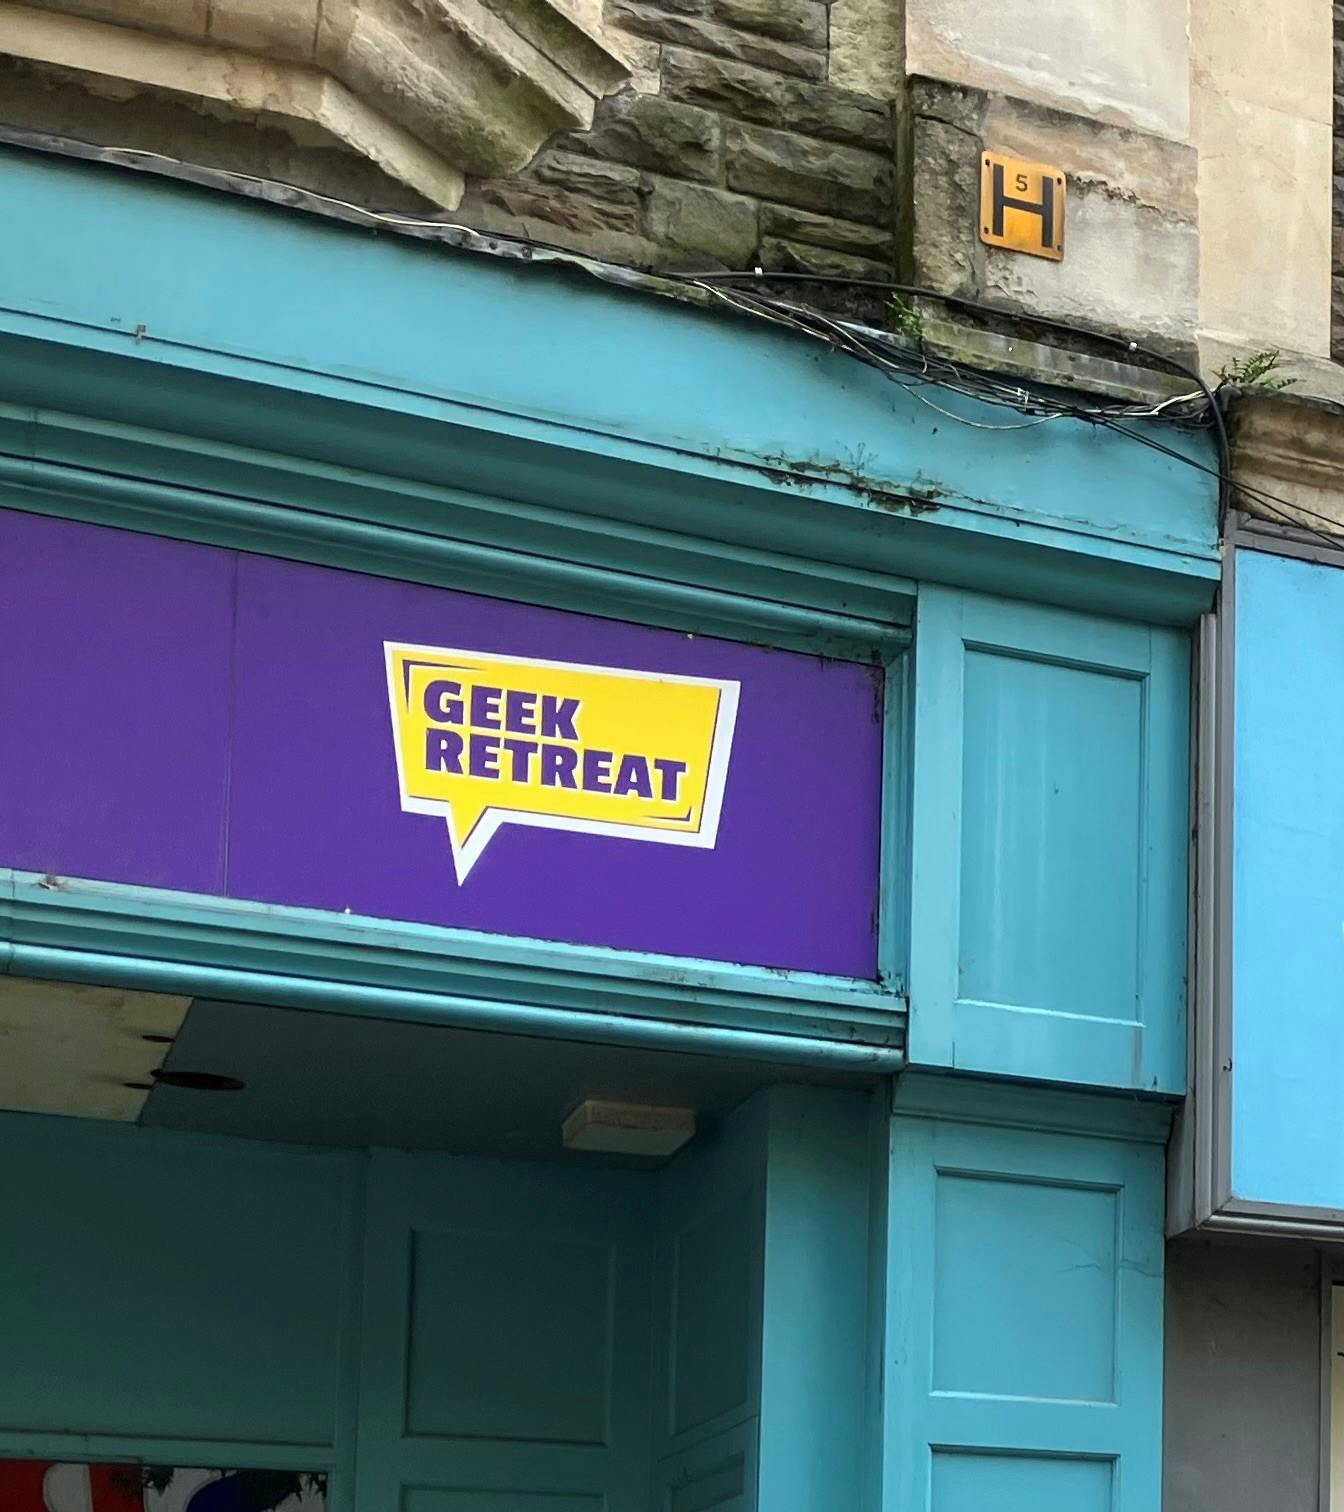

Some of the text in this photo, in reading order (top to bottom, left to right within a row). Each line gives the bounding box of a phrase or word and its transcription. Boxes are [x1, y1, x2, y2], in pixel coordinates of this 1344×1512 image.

[992, 163, 1054, 248] H
[1015, 173, 1028, 192] 5
[423, 679, 581, 741] GEEK
[425, 727, 687, 801] RETREAT
